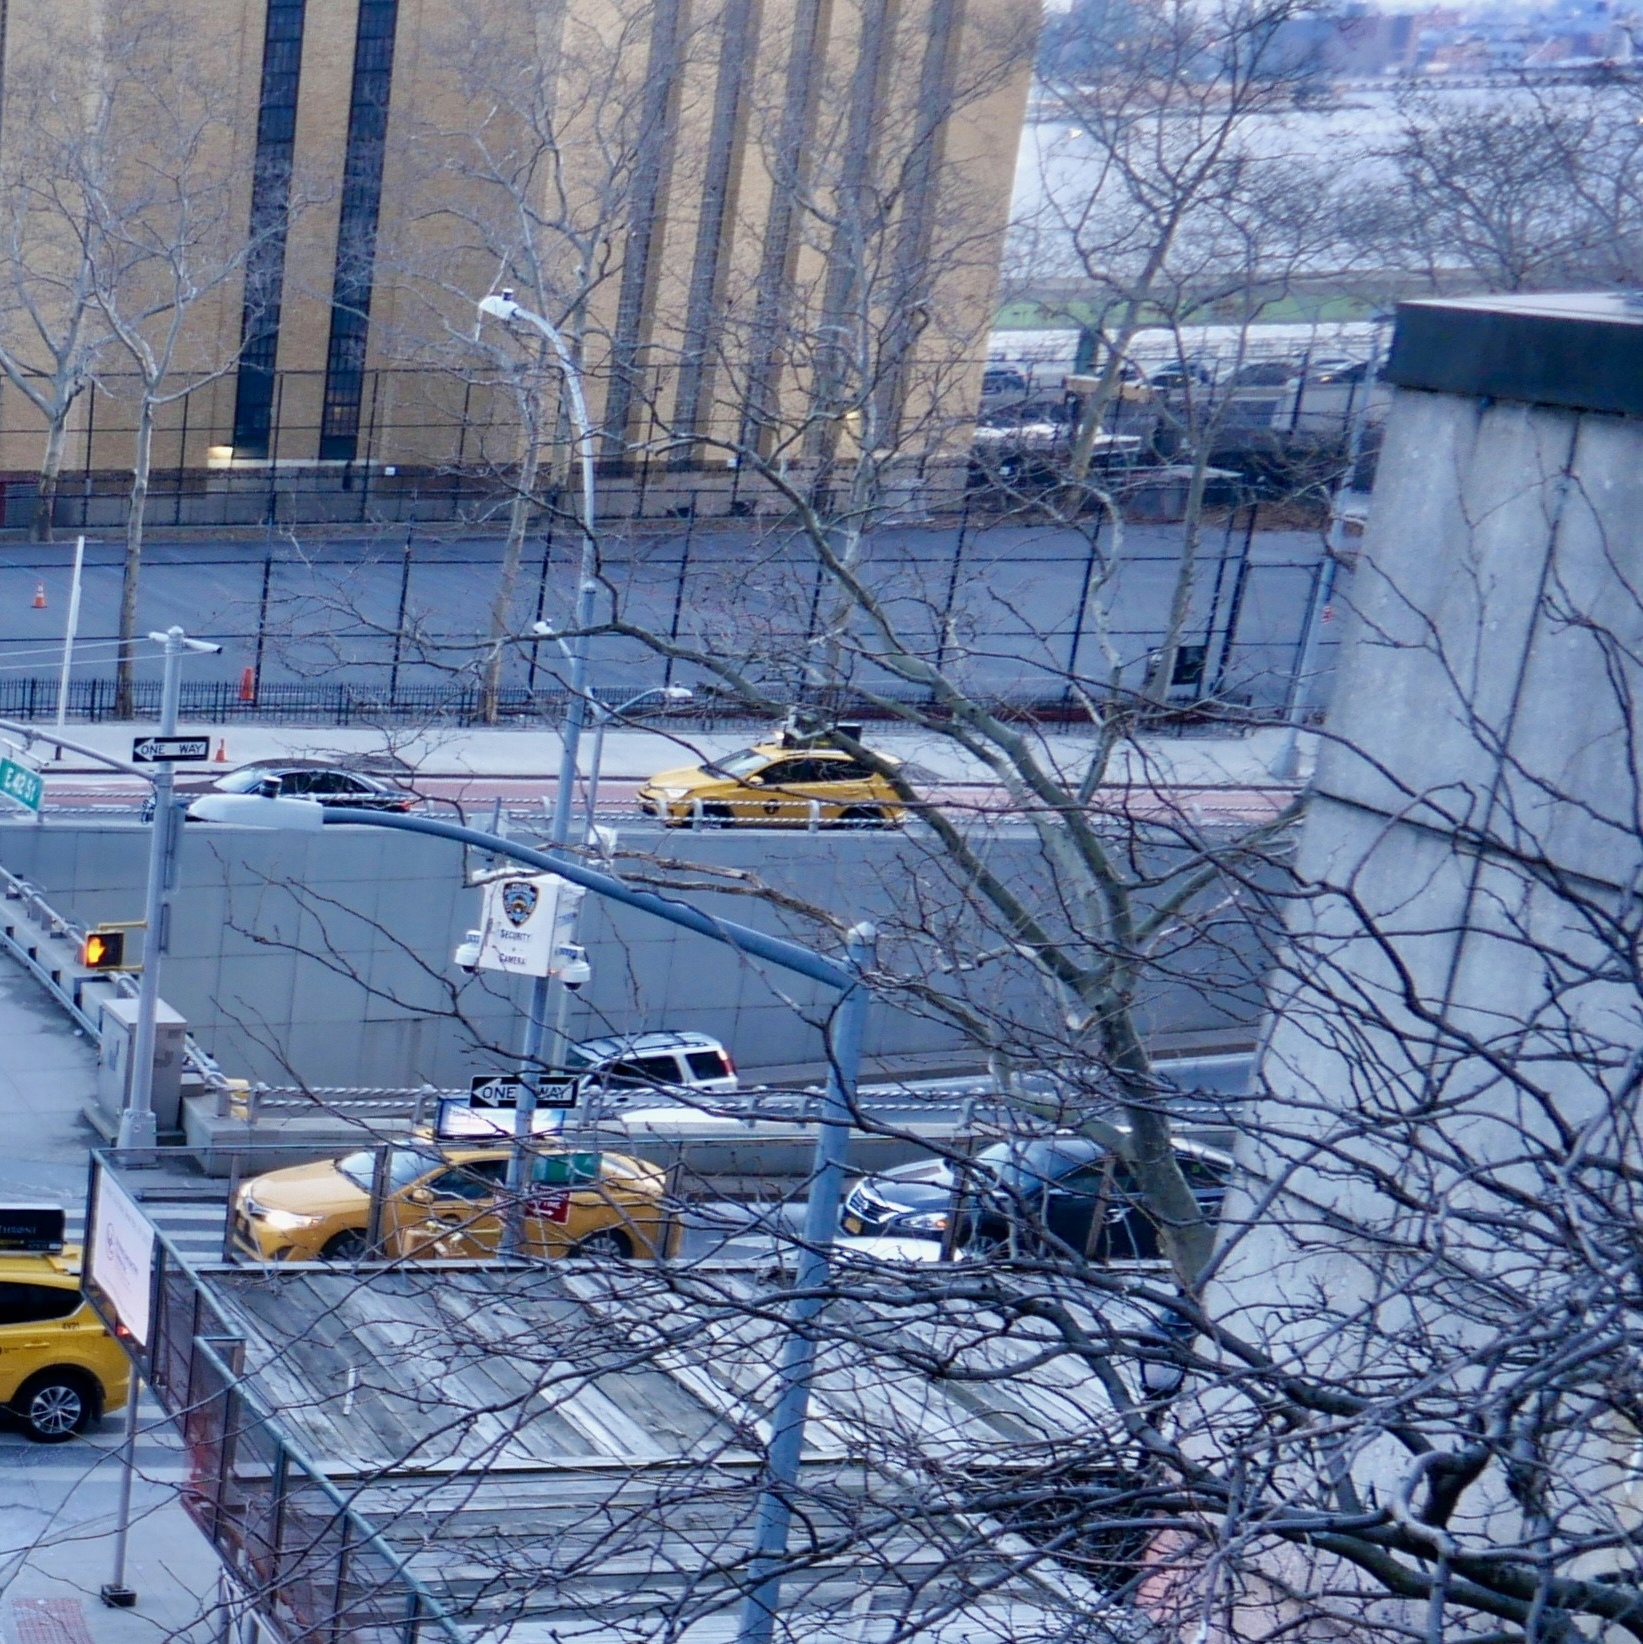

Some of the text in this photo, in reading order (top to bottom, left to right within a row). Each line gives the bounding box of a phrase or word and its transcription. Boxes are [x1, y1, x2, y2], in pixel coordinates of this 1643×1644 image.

[141, 743, 204, 756] ONE WAY
[3, 766, 14, 789] E
[14, 774, 26, 796] 42
[482, 1086, 565, 1100] ONE WAY
